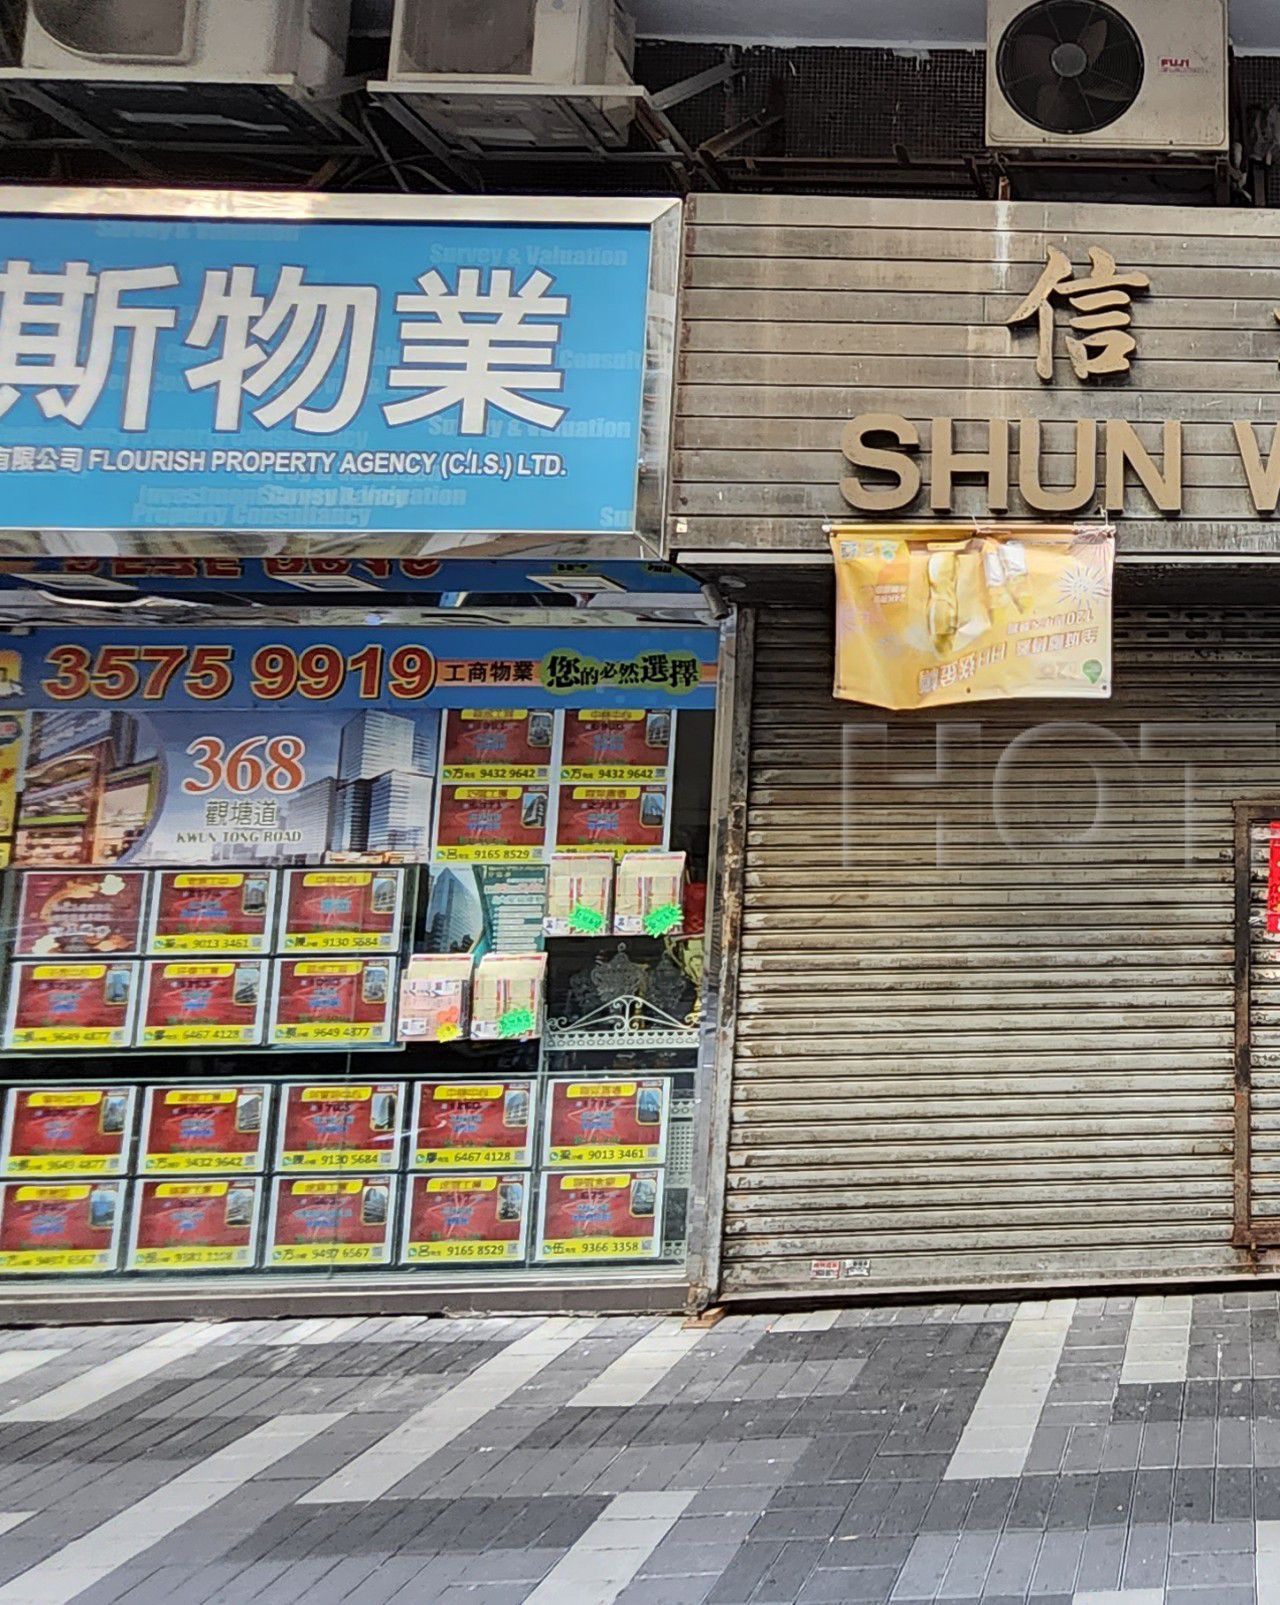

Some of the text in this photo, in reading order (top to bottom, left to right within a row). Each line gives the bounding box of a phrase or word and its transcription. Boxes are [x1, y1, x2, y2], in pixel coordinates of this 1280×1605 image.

[0, 261, 568, 435] 斯物業
[88, 449, 206, 472] FLOURISH
[211, 451, 334, 474] PROPERTY
[340, 452, 437, 474] AGENCY
[517, 454, 567, 477] LTD.
[839, 413, 1181, 513] SHUN
[44, 645, 436, 700] 3575 9919
[444, 661, 535, 682] 工商物業
[547, 654, 700, 688] 您的必然選擇
[181, 735, 306, 795] 368
[480, 767, 536, 779] 9432 9642
[598, 767, 653, 779] 9432 9642
[206, 801, 277, 827] 觀塘道
[176, 831, 302, 843] KWUN TONG ROAD
[474, 848, 531, 860] 9165 8529
[321, 937, 350, 948] 9130
[321, 1154, 349, 1165] 9130
[454, 1152, 511, 1163] 6467 4128
[588, 1148, 644, 1160] 9013 3461
[447, 1244, 504, 1256] 9165 8529
[582, 1242, 639, 1253] 9366 3358
